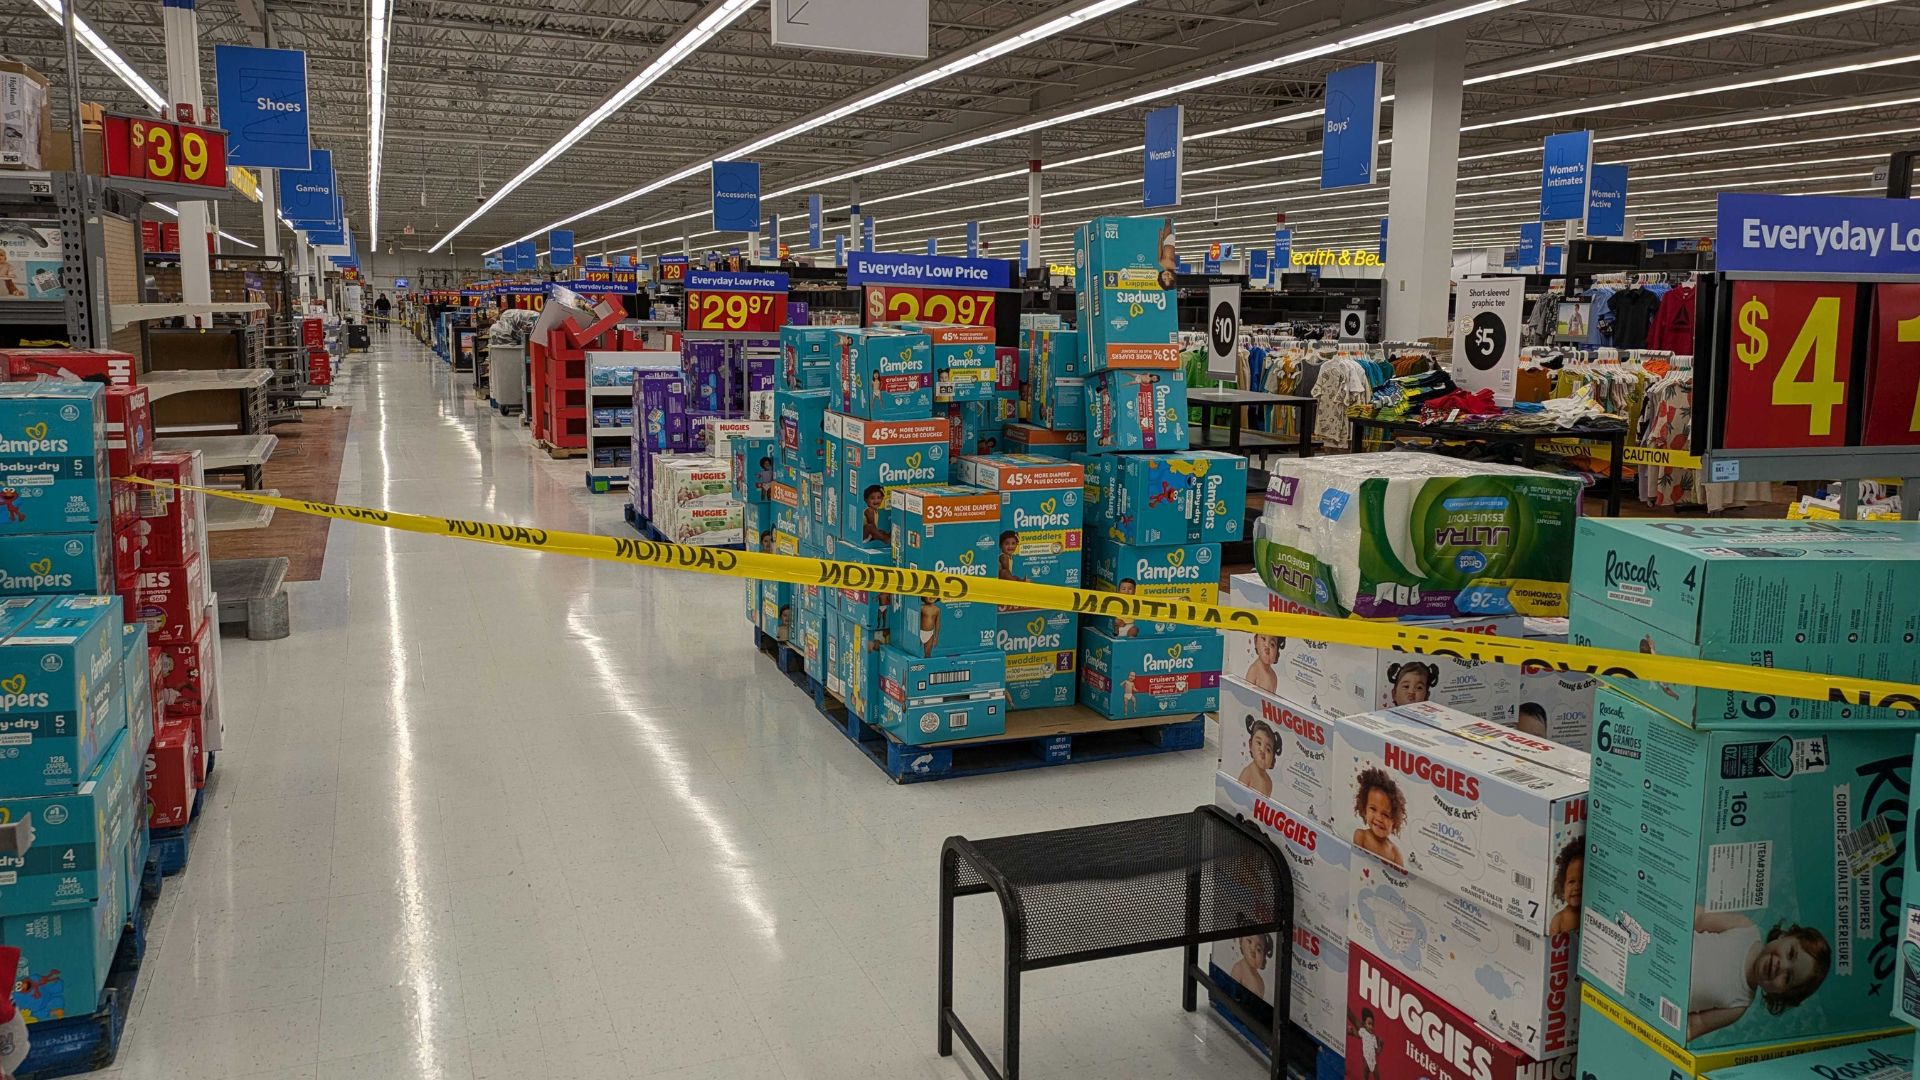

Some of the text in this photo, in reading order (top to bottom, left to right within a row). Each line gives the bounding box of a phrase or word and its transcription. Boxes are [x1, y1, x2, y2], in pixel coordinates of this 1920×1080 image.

[256, 97, 301, 113] Shoes
[1327, 117, 1350, 134] Boys'
[1149, 149, 1176, 161] Women's
[1549, 163, 1584, 176] Women's
[1873, 171, 1888, 182] E27
[1547, 175, 1584, 187] Intimates
[295, 184, 329, 195] Gaming
[716, 190, 757, 199] Accessories
[1591, 189, 1621, 199] Women's
[1590, 200, 1612, 209] Active
[1105, 230, 1119, 239] 120
[1742, 218, 1882, 257] Everyday
[1291, 249, 1334, 266] ealth
[1338, 249, 1351, 266] &
[858, 261, 988, 280] Everyday Low Price
[575, 284, 600, 292] Everyday
[691, 276, 775, 288] Everyday Low Price
[1116, 291, 1166, 310] Pampers
[1469, 288, 1510, 298] Short-sleeved
[1472, 299, 1506, 308] graphic tee
[942, 333, 959, 341] 45%
[1215, 316, 1232, 342] $10
[1475, 328, 1495, 356] $5
[948, 355, 981, 368] Pampers
[1154, 349, 1177, 360] 33%
[880, 357, 923, 373] Pampers
[850, 349, 858, 399] Pampers
[782, 402, 799, 420] Pampers
[1094, 390, 1102, 438] Pampers
[1156, 385, 1170, 434] Pampers
[872, 427, 897, 440] 45%
[1623, 448, 1670, 464] CAUTION
[74, 459, 83, 470] 5
[879, 462, 935, 483] Pampers
[691, 472, 726, 480] HUGGIES
[1006, 473, 1032, 486] 45%
[1105, 477, 1115, 519] Pampers
[1205, 475, 1222, 529] Pampers
[692, 509, 727, 517] HUGGIES
[927, 505, 953, 519] 33%
[1014, 508, 1069, 529] Pampers
[1448, 513, 1504, 523] ESSUIE-TOUT
[777, 512, 796, 534] Pampers
[1021, 533, 1062, 542] swaddlers
[1435, 526, 1511, 546] ULTRA
[935, 560, 987, 576] Pampers
[1066, 568, 1078, 576] 192
[1136, 559, 1199, 583] Pampers
[1460, 560, 1483, 569] Great
[1605, 550, 1697, 592] Rascals 4
[1271, 561, 1313, 595] ULTRA
[1144, 586, 1207, 597] swaddlers 2
[1531, 599, 1561, 607] FORMAT
[174, 625, 183, 636] 7
[980, 630, 994, 639] 120
[997, 629, 1060, 652] Pampers
[1574, 633, 1591, 647] 180
[1007, 655, 1068, 666] swaddlers 4
[1143, 653, 1194, 672] Pampers
[1208, 674, 1214, 682] 4
[1456, 675, 1477, 684] 100%
[1558, 678, 1598, 690] snug dry
[1055, 687, 1067, 695] 176
[1508, 705, 1515, 715] 4
[1600, 703, 1624, 720] Rascals
[1741, 695, 1776, 719] 6
[55, 715, 65, 726] 5
[1261, 699, 1325, 745] HUGGIES
[1563, 712, 1586, 720] 100%
[1597, 720, 1612, 752] 6
[1613, 735, 1641, 750] GRANDES
[1805, 741, 1824, 770] #1
[1384, 742, 1480, 801] HUGGIES
[173, 807, 182, 818] 7
[1433, 794, 1480, 821] snug & dry
[1731, 790, 1748, 827] 160
[1836, 793, 1847, 840] COUCHES
[1253, 799, 1317, 851] HUGGIES
[1437, 822, 1464, 842] 100%
[63, 849, 75, 861] 4
[1459, 898, 1482, 918] 100%
[1528, 901, 1539, 918] 7
[1859, 890, 1871, 931] DIAPERS
[1545, 933, 1570, 1052] HUGGIES
[1359, 959, 1492, 1080] HUGGIES
[1584, 989, 1596, 1003] SUPER
[1608, 1006, 1620, 1019] PACK
[1623, 1017, 1637, 1031] SUPER
[1637, 1025, 1662, 1048] EMBALLAGE
[1527, 1025, 1536, 1043] 7
[1406, 1040, 1437, 1074] little
[1734, 1051, 1784, 1066] SUPER VALUE
